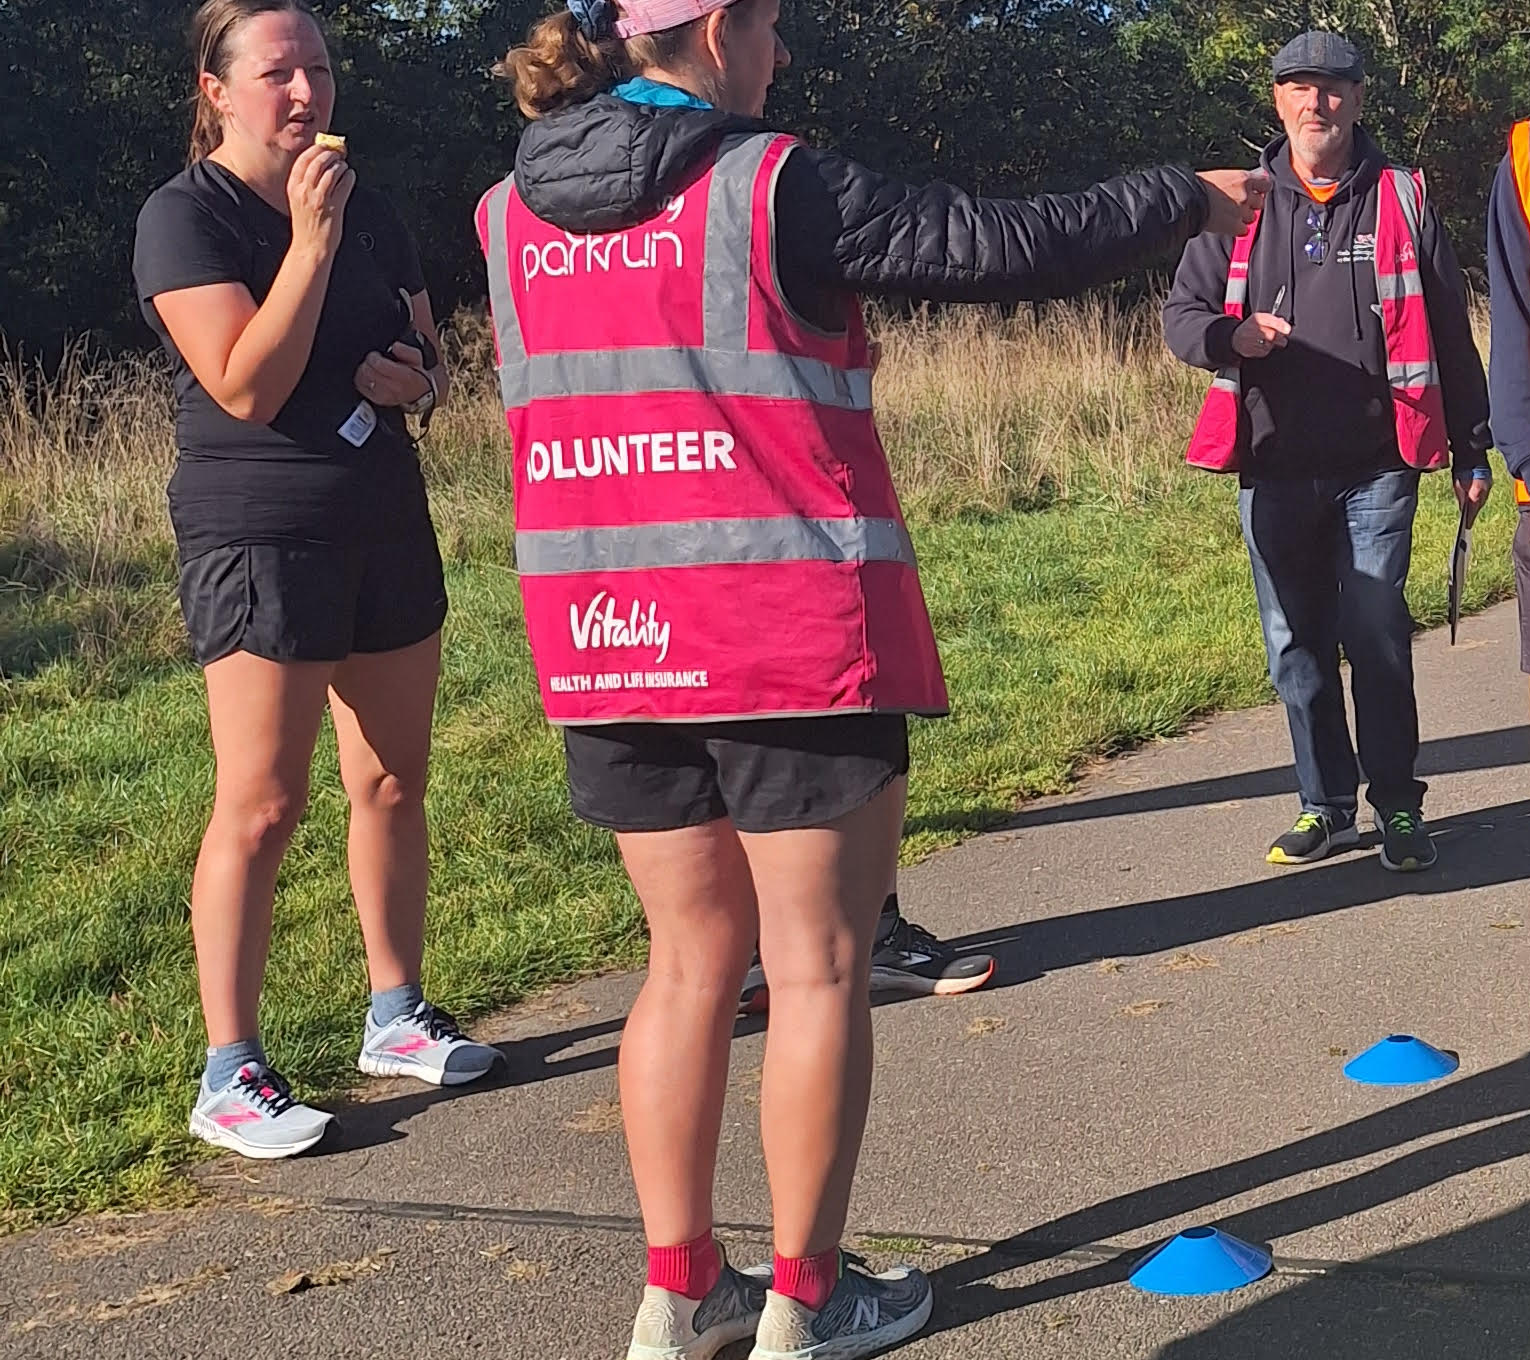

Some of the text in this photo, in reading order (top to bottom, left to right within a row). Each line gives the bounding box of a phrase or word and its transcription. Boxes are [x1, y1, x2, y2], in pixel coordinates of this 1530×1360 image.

[523, 231, 682, 292] parkrun
[527, 430, 737, 485] OLUNTEER
[569, 590, 671, 665] Vitality
[550, 673, 592, 693] HEALTH
[594, 673, 622, 691] AND
[645, 670, 709, 689] INSURANCE
